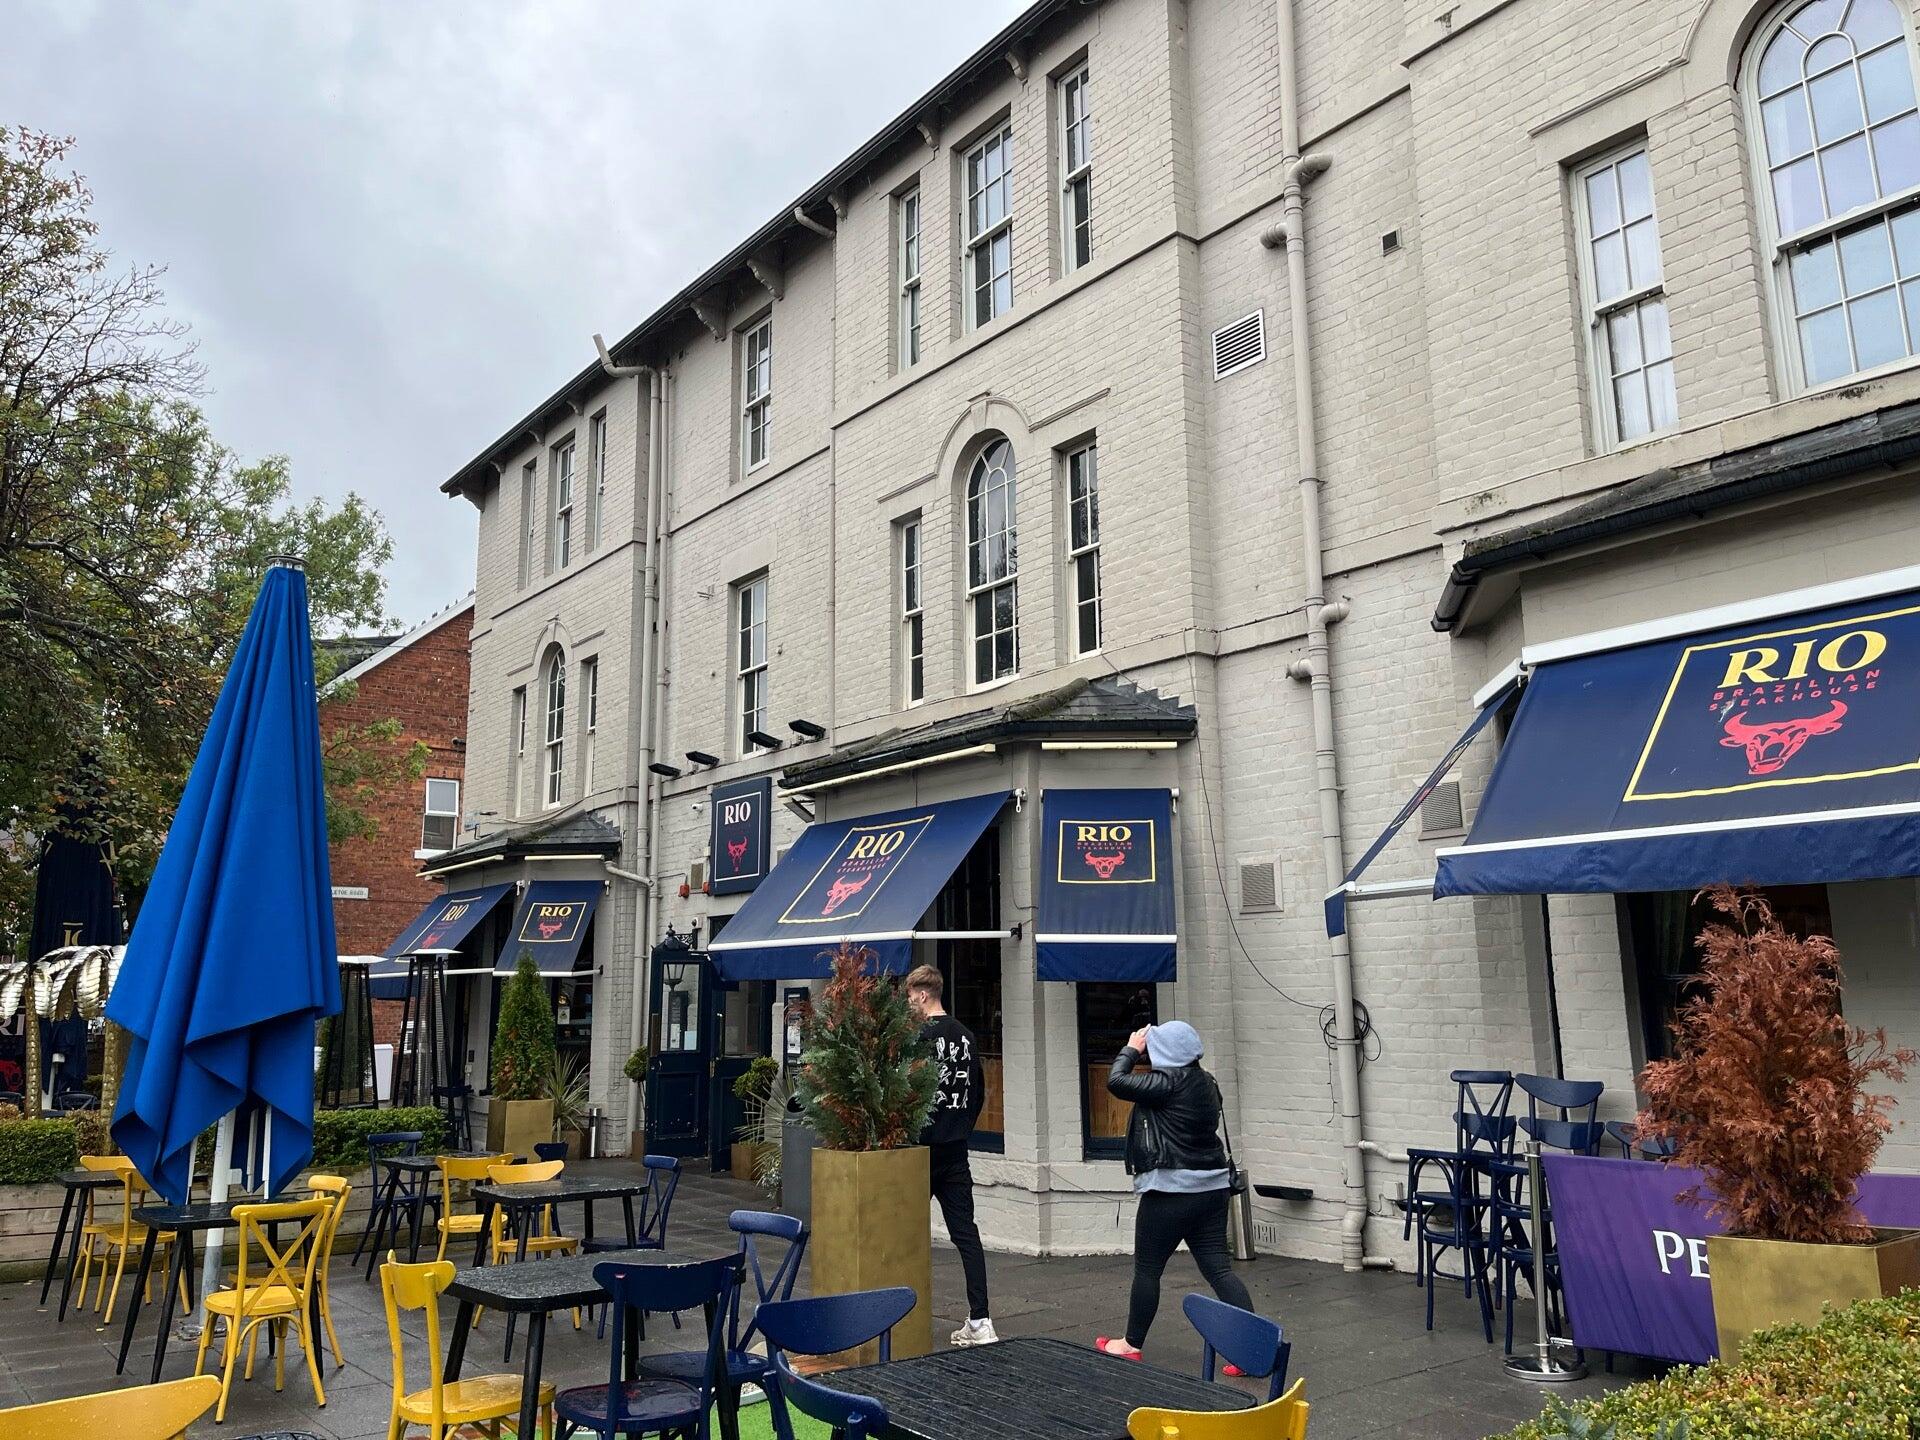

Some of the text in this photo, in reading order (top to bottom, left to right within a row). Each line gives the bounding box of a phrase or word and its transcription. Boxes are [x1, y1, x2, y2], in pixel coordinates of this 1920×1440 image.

[1717, 630, 1887, 689] RIO
[1713, 669, 1881, 701] BRAZILIAN
[724, 801, 751, 825] RIO
[847, 831, 905, 859] RIO
[1077, 826, 1132, 842] RIO
[441, 904, 470, 921] RIO
[539, 906, 572, 917] RIO
